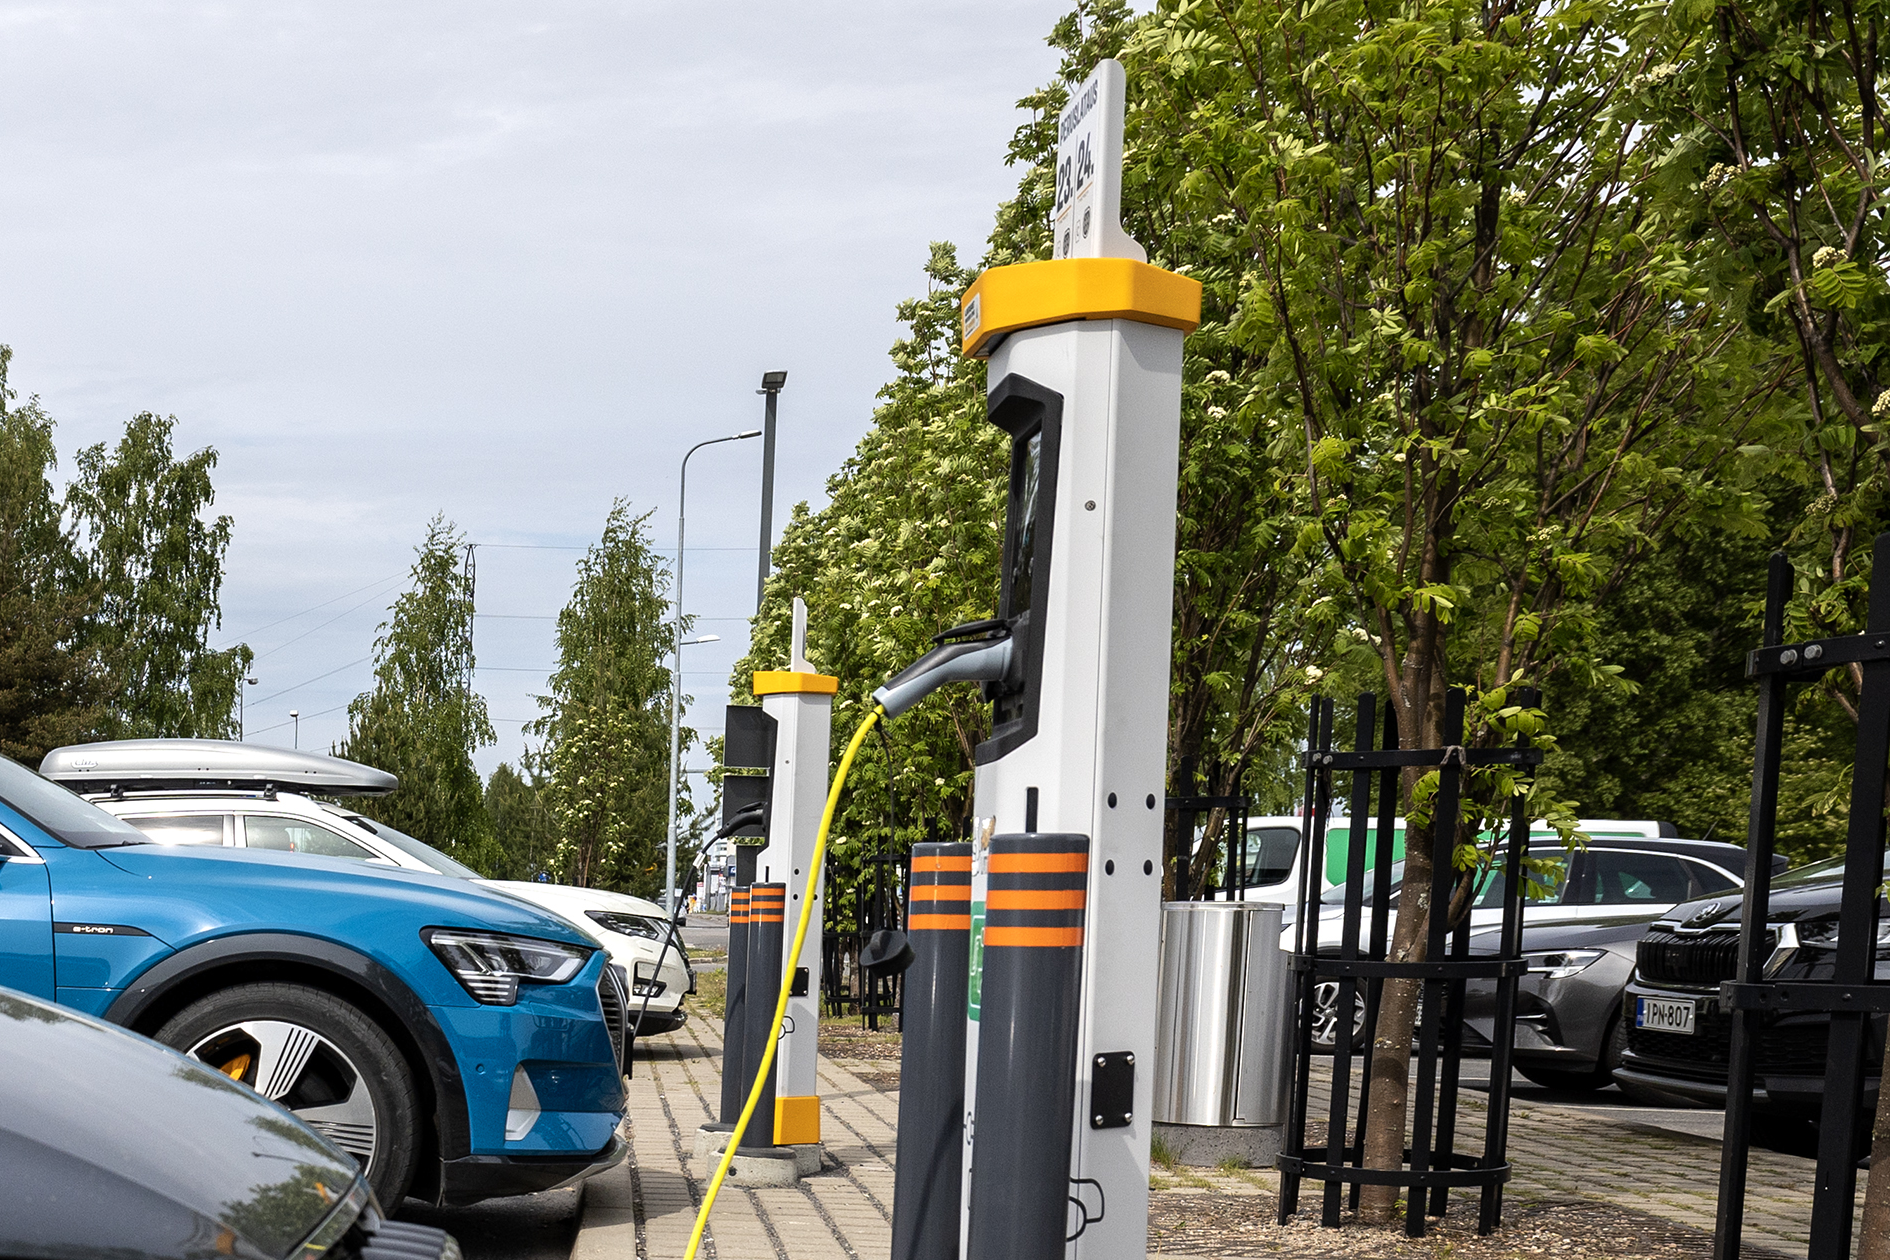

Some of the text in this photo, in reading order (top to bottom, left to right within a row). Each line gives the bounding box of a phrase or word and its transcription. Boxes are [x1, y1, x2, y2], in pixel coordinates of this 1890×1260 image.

[1059, 79, 1099, 144] PERUSLATAUS
[1056, 156, 1074, 212] 23.
[1076, 131, 1094, 191] 24.
[73, 925, 114, 934] e-tron
[1646, 1002, 1691, 1028] IPN-807
